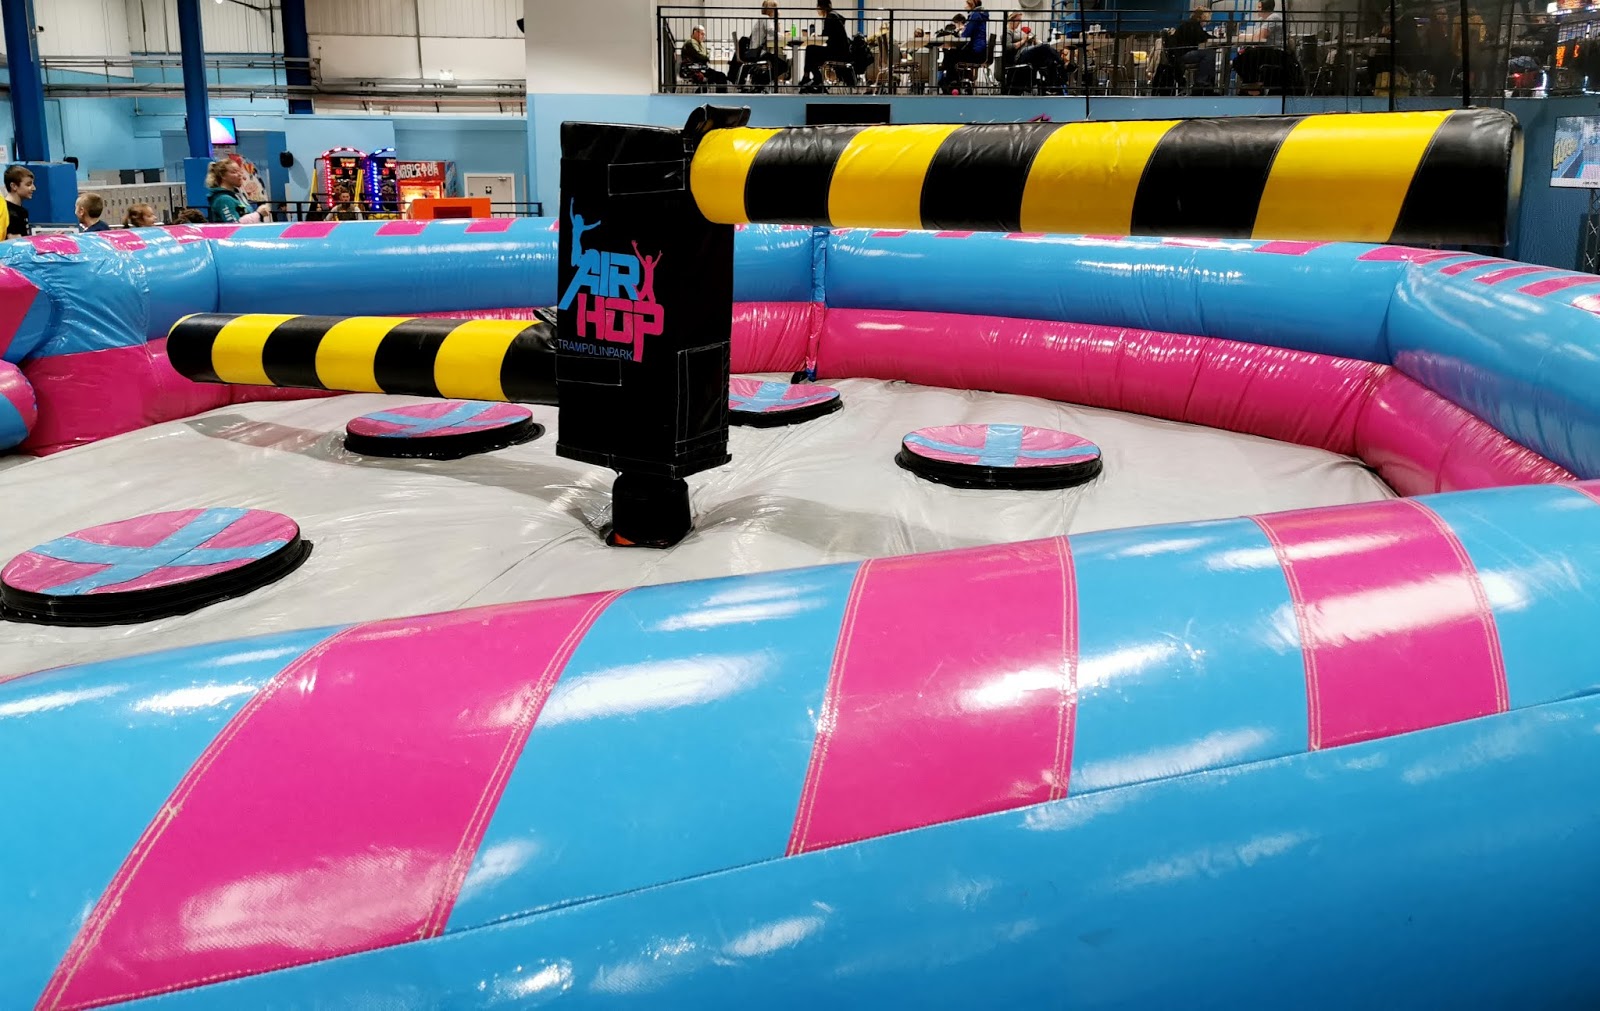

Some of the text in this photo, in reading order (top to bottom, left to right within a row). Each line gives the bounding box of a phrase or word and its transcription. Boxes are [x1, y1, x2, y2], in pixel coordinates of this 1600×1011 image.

[558, 249, 640, 310] AIR
[558, 339, 633, 361] TRAMPOLINPARK
[577, 293, 665, 363] HOP
